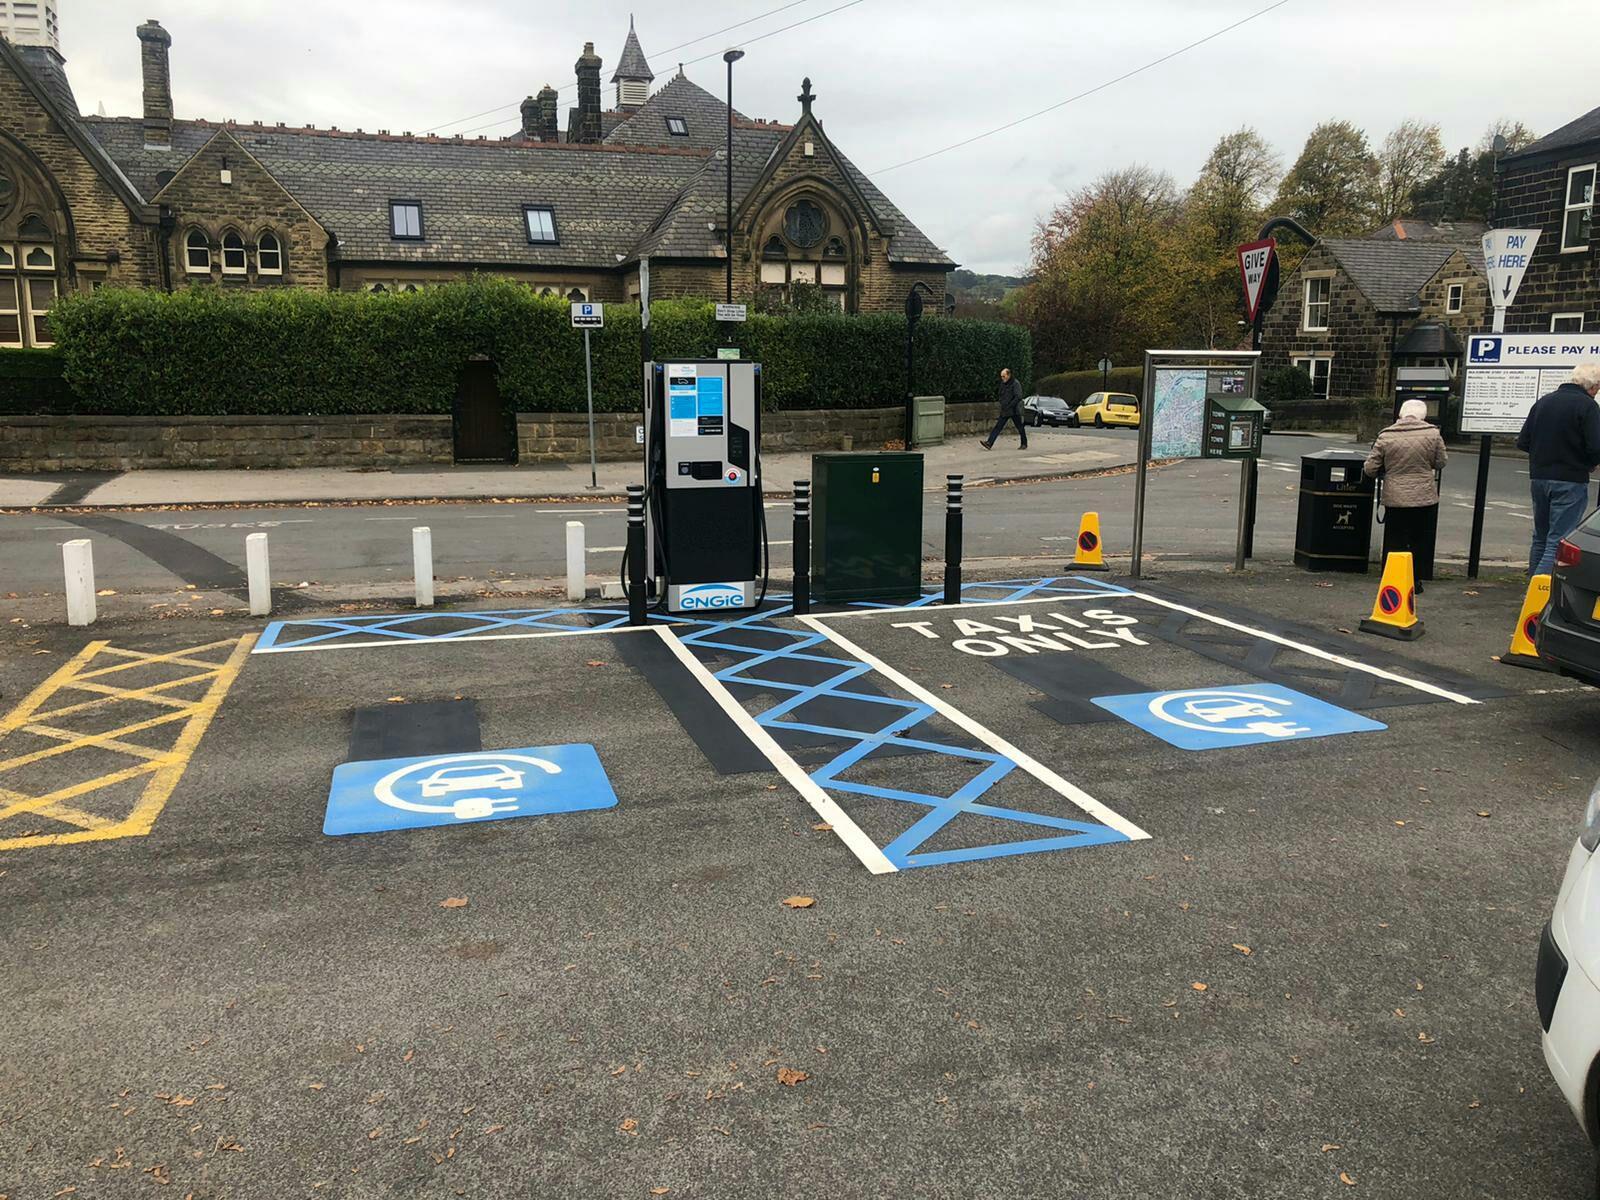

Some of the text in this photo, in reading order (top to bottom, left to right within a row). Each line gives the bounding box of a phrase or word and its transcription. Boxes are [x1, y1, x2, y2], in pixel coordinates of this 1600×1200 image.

[1506, 236, 1526, 249] PAY
[1245, 252, 1265, 270] GIVE
[1498, 255, 1527, 268] HERE
[1248, 272, 1261, 284] WAY
[1478, 340, 1495, 357] P
[1507, 346, 1600, 355] PLEASE PAY H
[1336, 482, 1356, 491] Litter
[891, 609, 1139, 639] TAXIS
[952, 627, 1150, 657] ONLY
